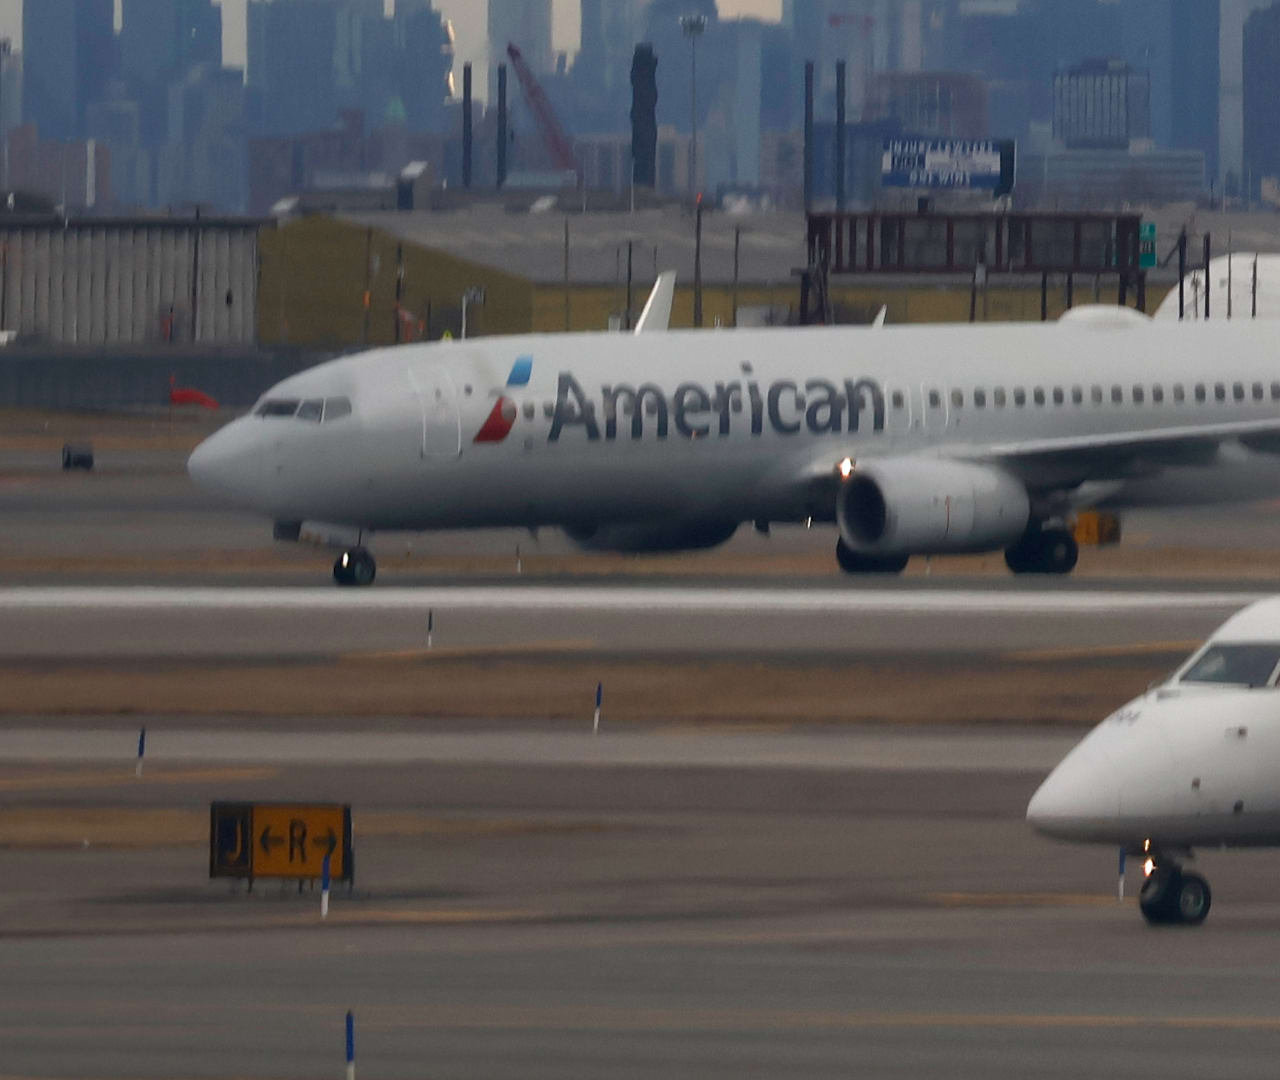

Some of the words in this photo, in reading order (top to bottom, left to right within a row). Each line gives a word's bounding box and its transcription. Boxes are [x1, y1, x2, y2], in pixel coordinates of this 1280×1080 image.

[547, 360, 885, 442] American
[227, 818, 242, 863] J
[288, 818, 307, 864] R
